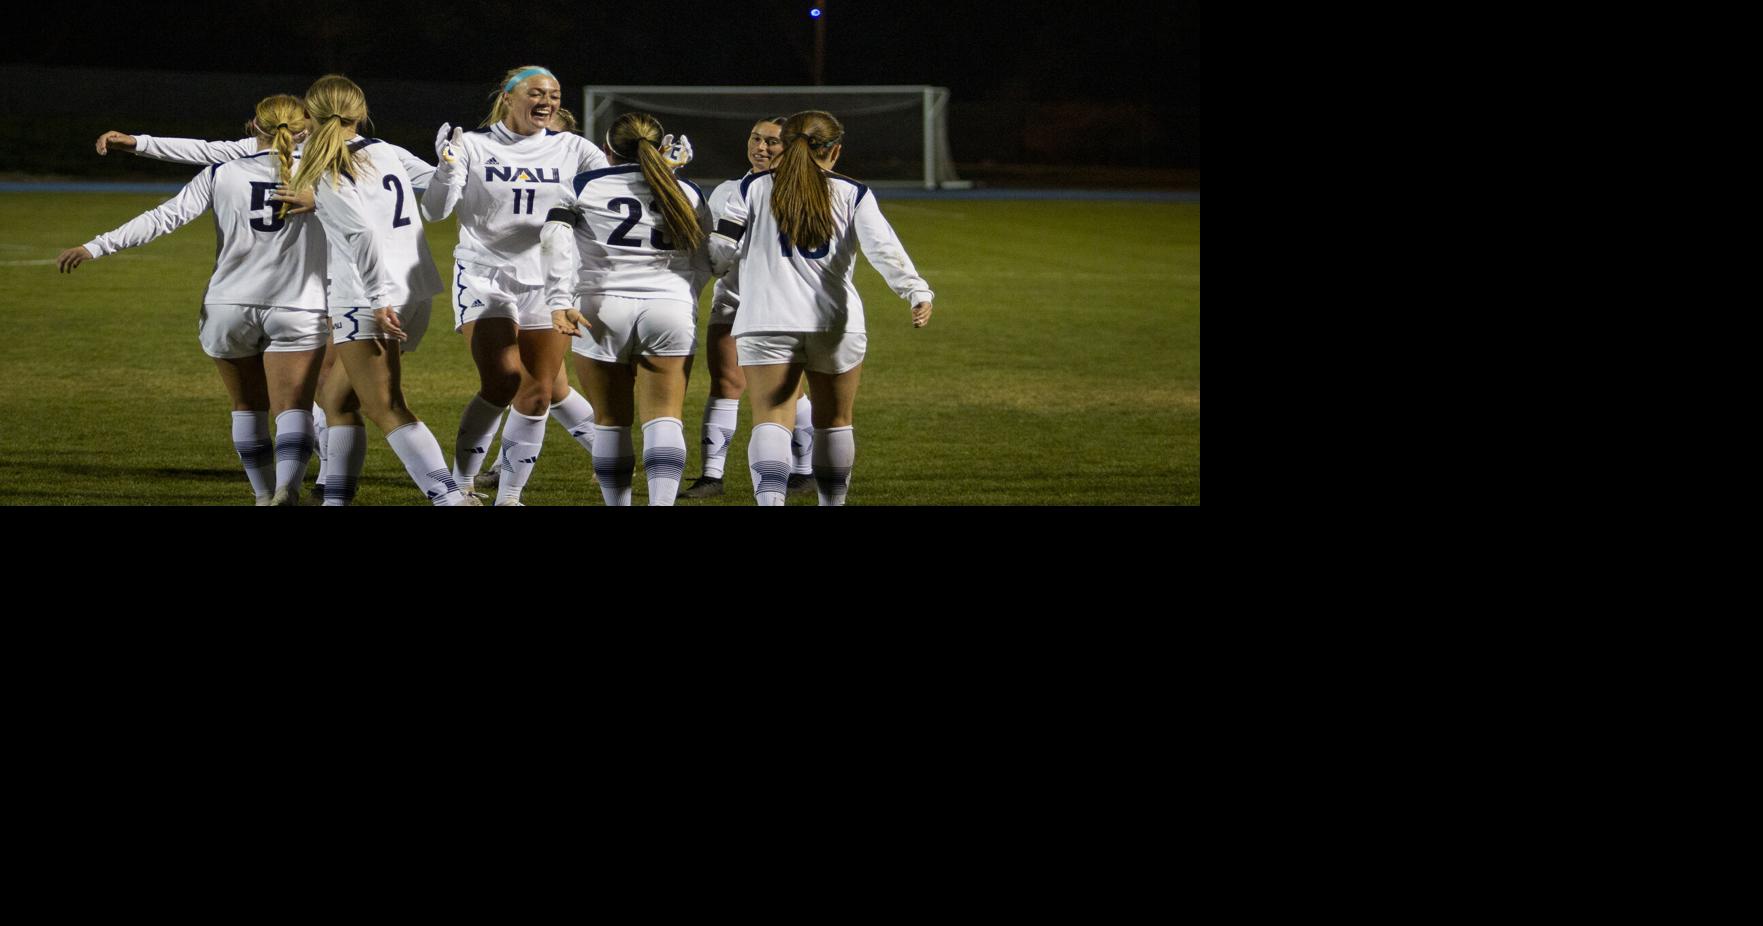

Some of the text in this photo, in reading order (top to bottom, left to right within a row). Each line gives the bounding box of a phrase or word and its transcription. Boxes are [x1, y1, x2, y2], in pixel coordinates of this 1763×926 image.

[485, 166, 560, 183] NAU
[250, 181, 286, 232] 5
[383, 174, 411, 228] 2
[512, 188, 535, 214] 11
